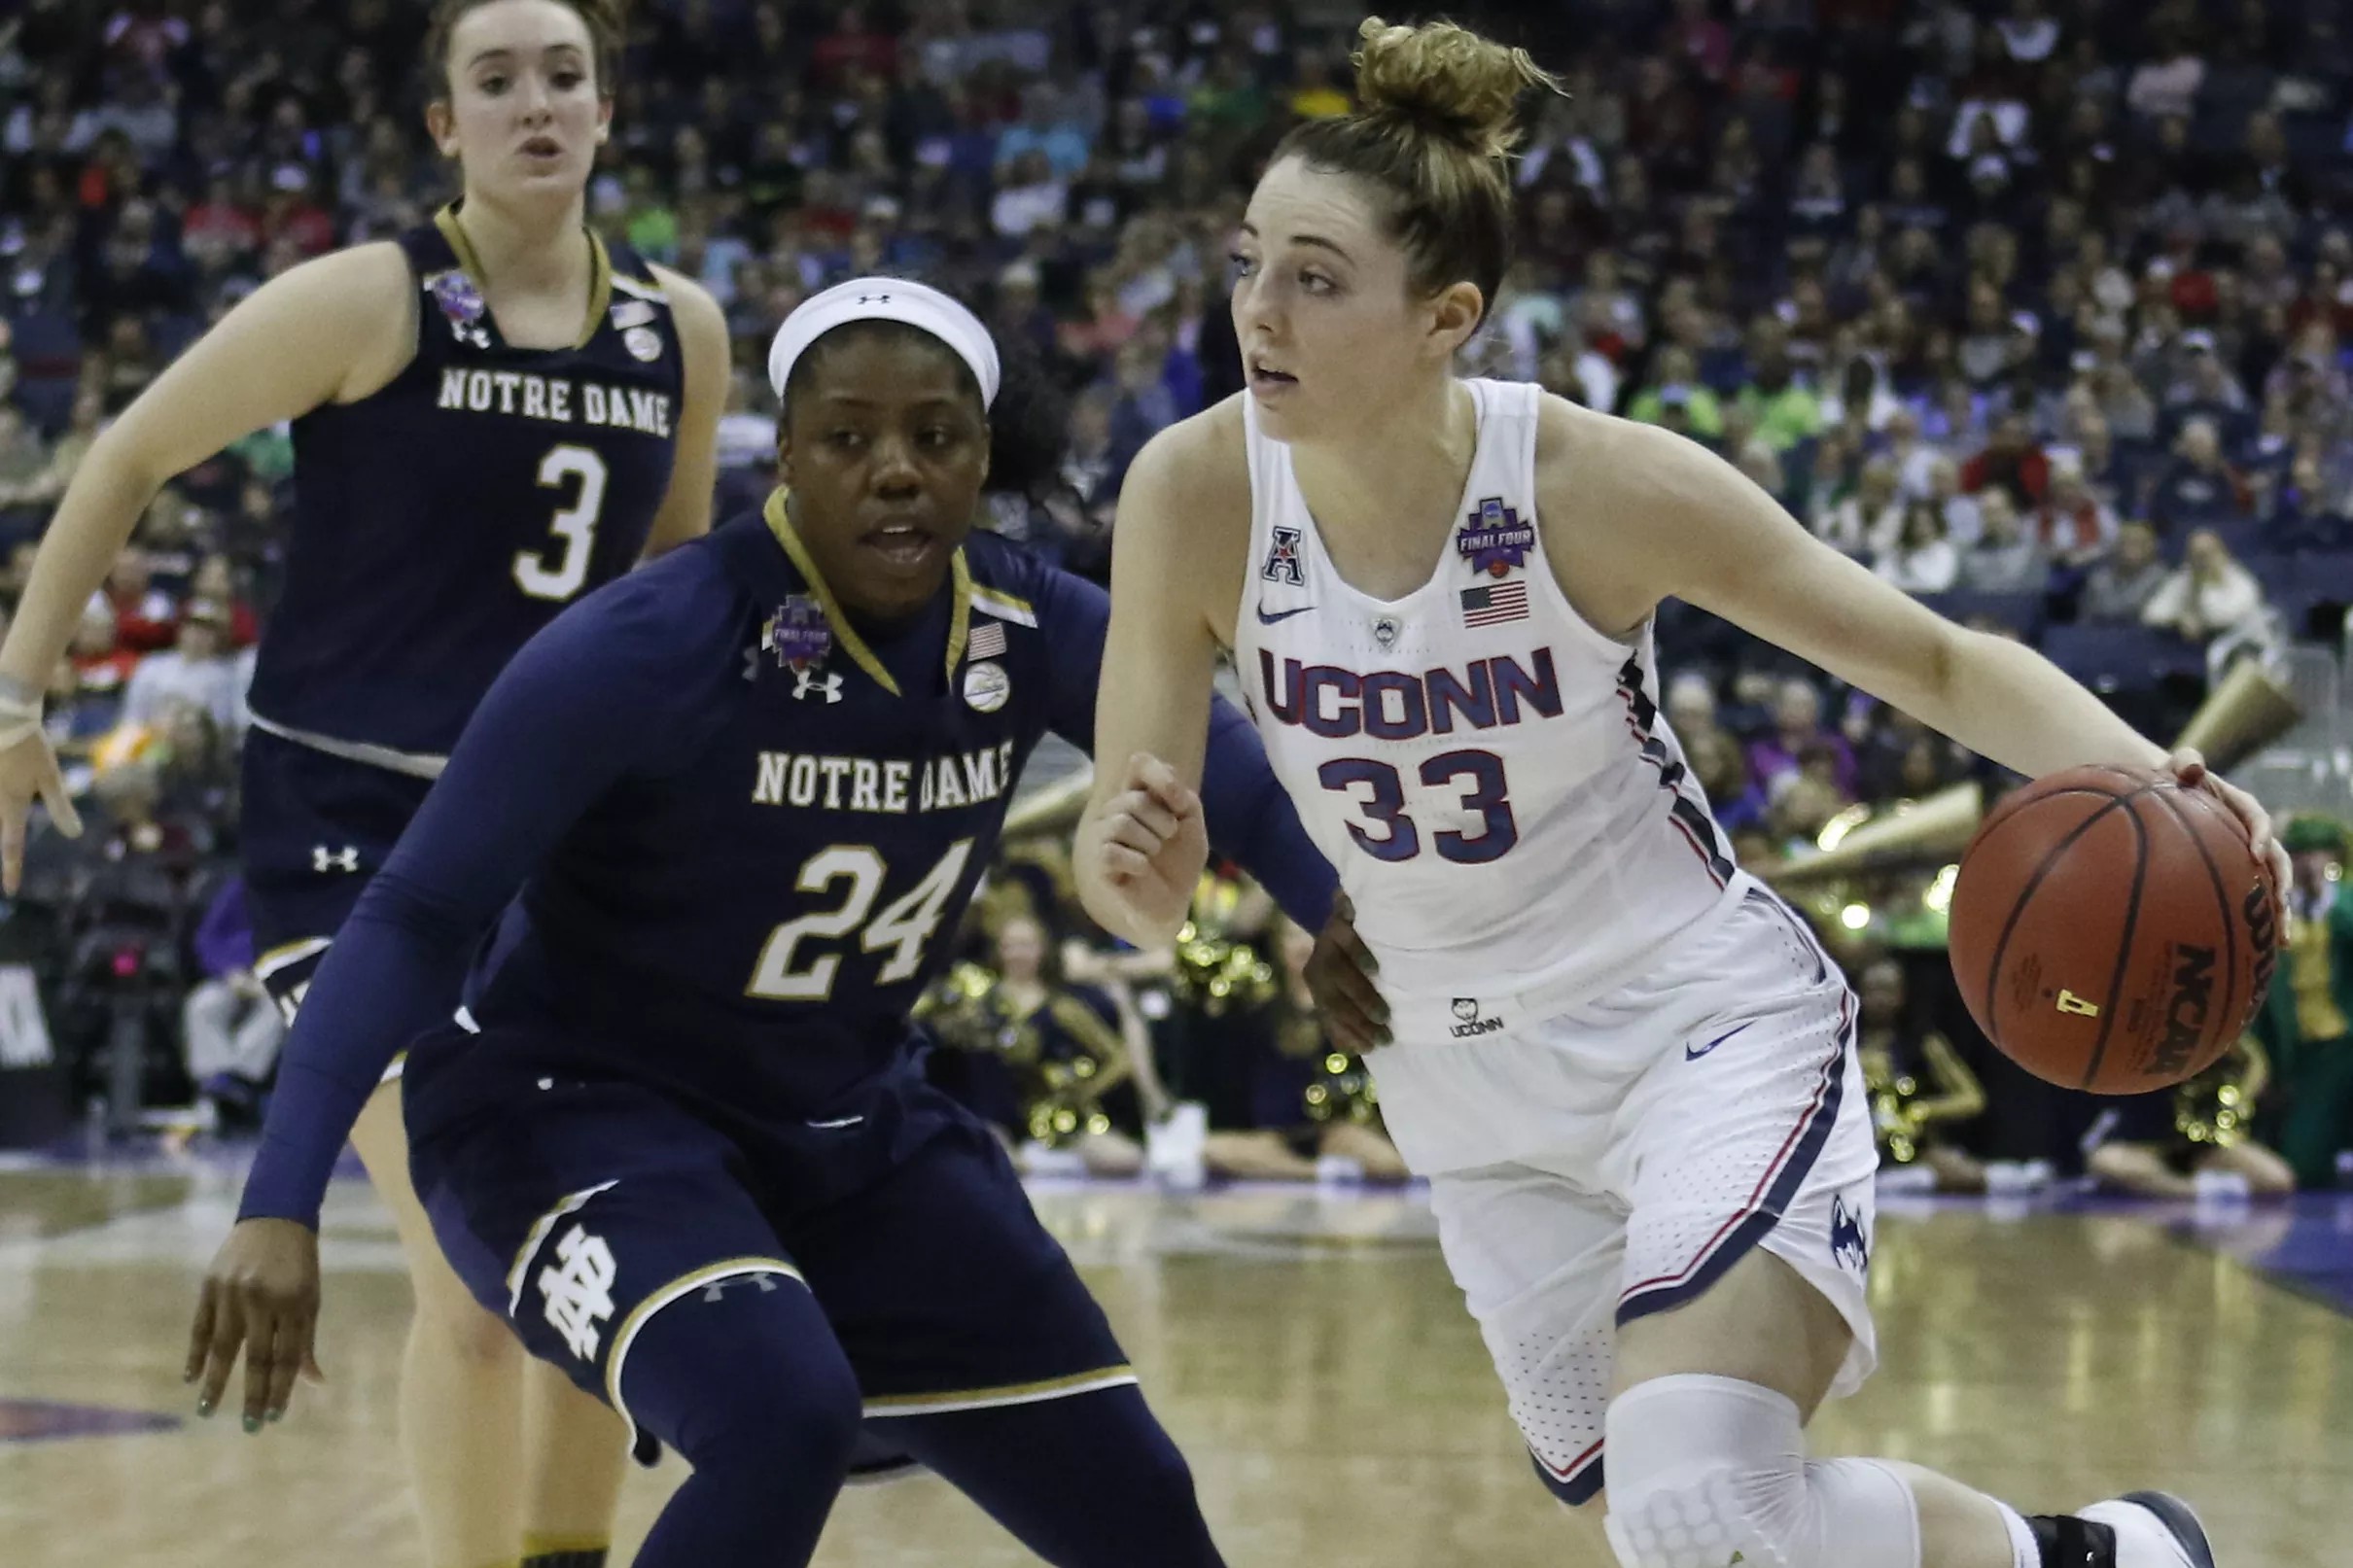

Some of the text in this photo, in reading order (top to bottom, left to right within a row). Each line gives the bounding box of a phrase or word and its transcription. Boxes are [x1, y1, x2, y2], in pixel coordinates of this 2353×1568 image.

[438, 366, 672, 439] NOTRE DAME
[511, 440, 609, 602] 3
[1459, 529, 1532, 552] FINAL FOUR
[1257, 645, 1565, 741] UCONN
[752, 738, 1014, 815] NOTRE DAME
[1317, 748, 1519, 865] 33
[743, 836, 975, 1003] 24
[1448, 1015, 1505, 1038] UCONN
[2144, 943, 2217, 1075] NCAA
